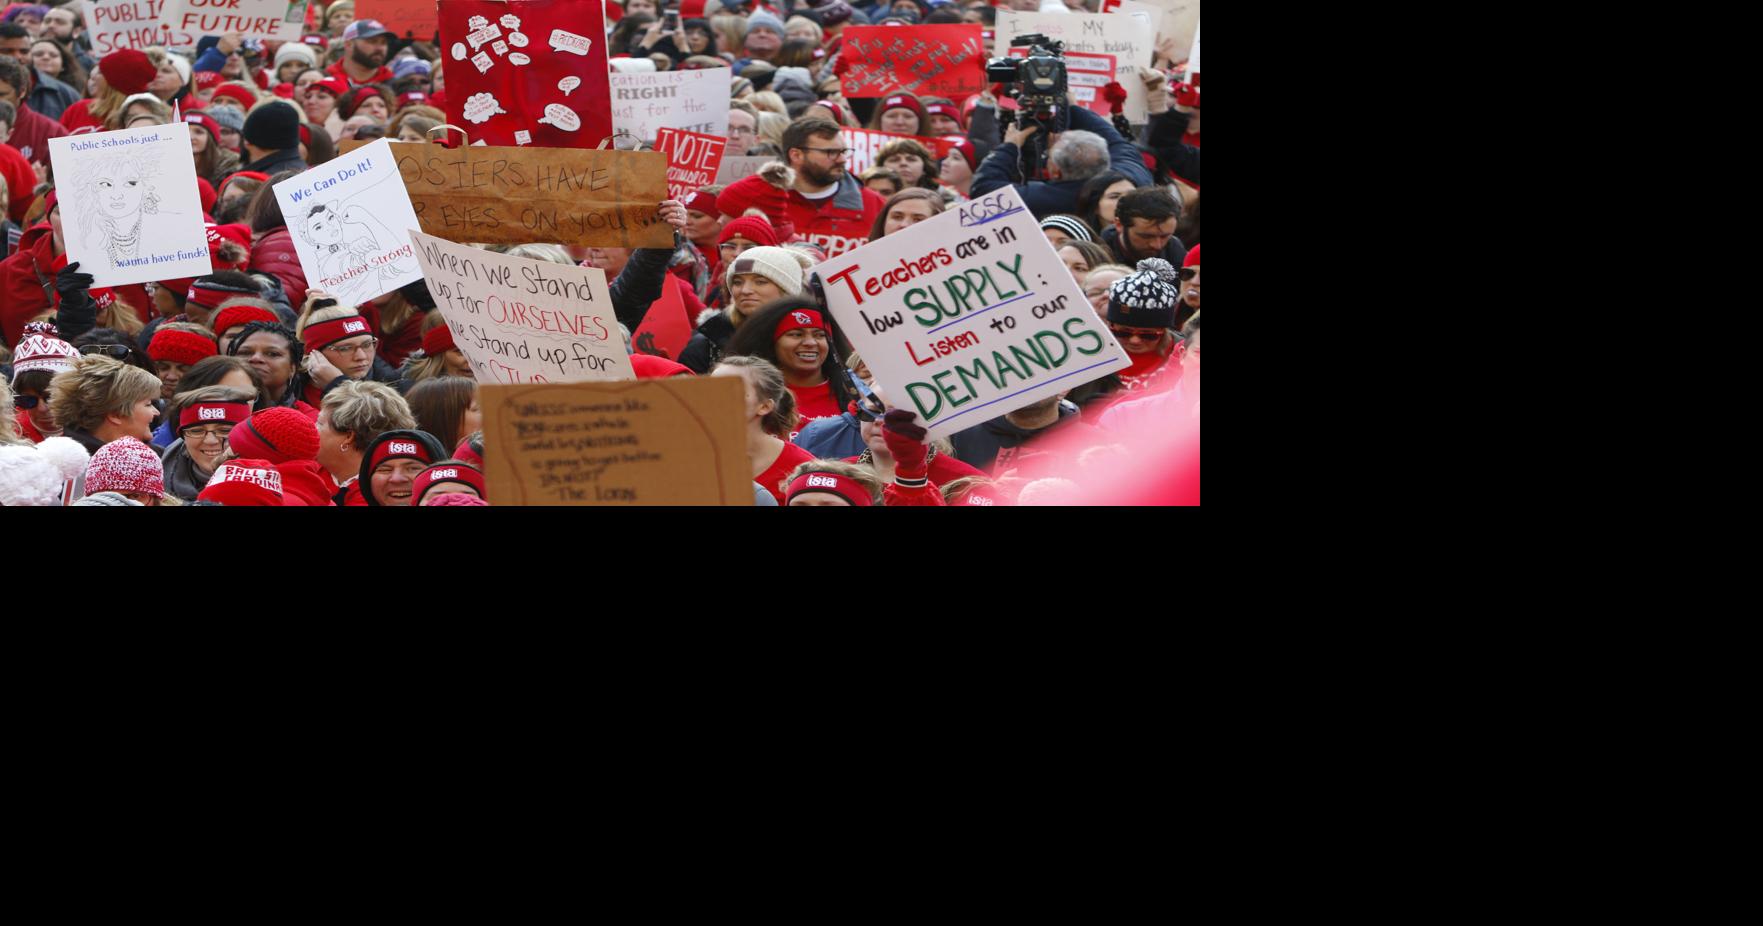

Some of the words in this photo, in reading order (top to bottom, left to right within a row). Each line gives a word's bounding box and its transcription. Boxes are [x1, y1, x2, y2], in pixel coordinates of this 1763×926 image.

[94, 0, 164, 25] PUBLI
[181, 13, 282, 35] FUTURE
[617, 86, 677, 100] RIGHT
[645, 103, 670, 117] for
[70, 141, 100, 152] Public
[101, 137, 139, 148] Schools
[139, 133, 160, 145] just
[672, 132, 724, 170] VOTE
[290, 188, 312, 203] We
[313, 177, 337, 192] Can
[337, 169, 356, 181] Do
[357, 158, 373, 174] It!
[537, 165, 609, 192] HAVE
[441, 206, 501, 229] EYES
[521, 207, 558, 230] ON
[958, 193, 1013, 228] ACSC
[116, 257, 149, 268] wanna
[151, 252, 175, 264] have
[177, 247, 209, 262] funds!
[320, 263, 369, 288] Teacher
[371, 244, 413, 265] Strong
[415, 237, 478, 280] When
[826, 246, 954, 306] Teachers
[955, 233, 990, 260] are
[996, 223, 1017, 245] in
[859, 310, 904, 335] low
[903, 253, 1031, 327] SUPPLY
[431, 277, 452, 310] up
[456, 282, 485, 315] for
[487, 295, 608, 341] OURSELVES
[905, 328, 980, 368] Listen
[990, 314, 1017, 334] to
[1031, 293, 1069, 320] our
[537, 346, 567, 375] up
[572, 343, 616, 372] for
[198, 406, 226, 420] ista
[388, 441, 417, 455] ista
[225, 466, 258, 477] BALL
[429, 468, 458, 482] ista
[806, 474, 837, 488] ista
